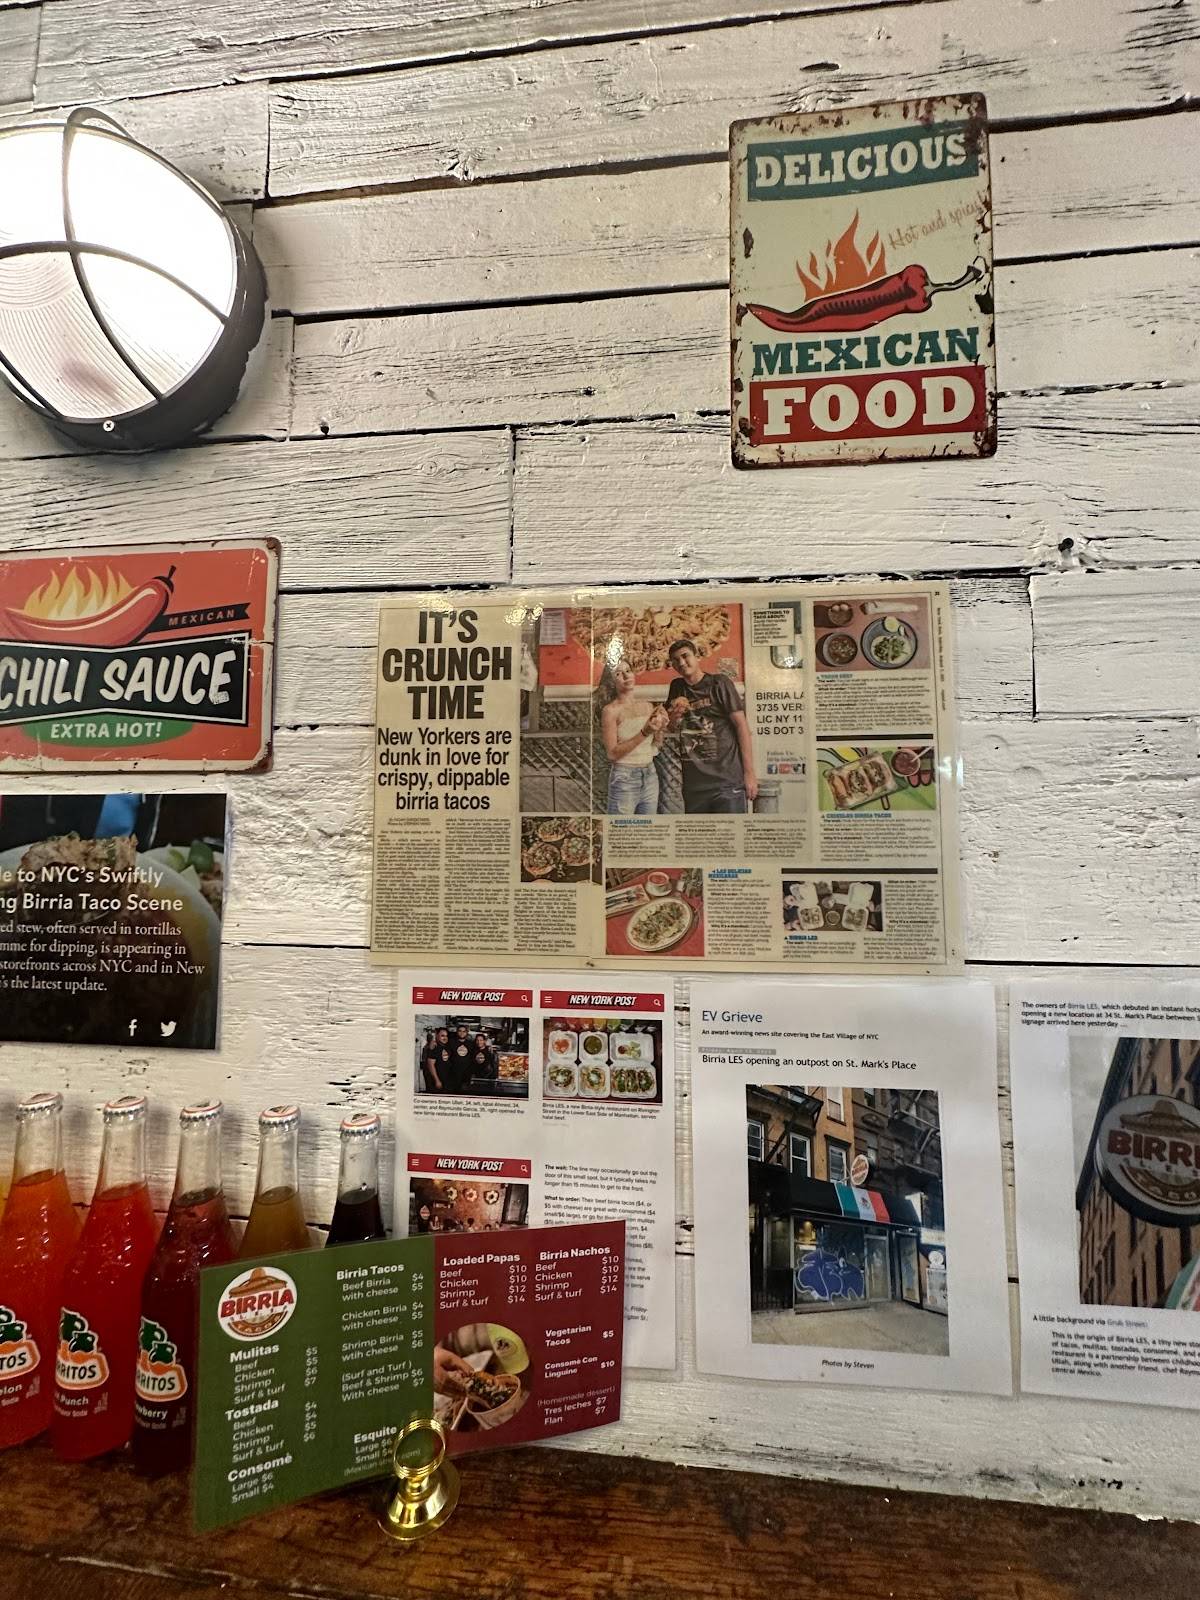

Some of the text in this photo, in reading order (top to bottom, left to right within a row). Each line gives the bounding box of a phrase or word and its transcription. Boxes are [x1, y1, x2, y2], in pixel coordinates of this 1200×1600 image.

[755, 133, 968, 188] DELICIOUS
[889, 225, 918, 250] Hot
[752, 326, 980, 377] MEXICAN
[762, 375, 976, 437] FOOD
[168, 608, 236, 628] MEXICAN
[418, 609, 479, 645] IT'S
[381, 646, 512, 682] CRUNCH
[0, 650, 237, 710] CHILI SAUCE
[407, 685, 485, 720] TIME
[756, 691, 790, 701] BIRRIA
[756, 702, 805, 712] 3735 VER
[756, 715, 773, 723] LIC
[775, 715, 790, 723] NY
[50, 721, 163, 739] EXTRA HOT!
[377, 727, 512, 746] New Yorkers are
[757, 726, 805, 735] US DOT 3
[379, 747, 510, 766] dunk in love for
[377, 768, 510, 791] crispy, dippable
[396, 791, 491, 810] birria tacos
[17, 868, 36, 882] to
[41, 867, 94, 883] NYC's
[98, 867, 164, 888] Swiftly
[23, 892, 73, 910] Birria
[78, 893, 122, 911] Taco
[127, 893, 184, 911] Scene
[16, 924, 45, 936] stew,
[47, 920, 77, 935] often
[80, 921, 117, 936] served
[120, 924, 132, 936] in
[134, 922, 182, 937] tortillas
[29, 938, 48, 952] for
[49, 939, 98, 957] dipping,
[100, 942, 111, 954] is
[113, 943, 172, 959] appearing
[174, 942, 187, 955] in
[0, 957, 206, 976] storefronts across NYC and in New
[11, 975, 30, 989] the
[32, 976, 62, 990] latest
[64, 977, 108, 995] update.
[440, 991, 506, 1003] NEW YORK POST
[570, 994, 637, 1007] NEW YORK POST
[701, 1010, 763, 1023] EV Grieve
[1102, 1003, 1121, 1011] which
[1122, 1004, 1150, 1012] debuted
[1161, 1005, 1184, 1013] instant
[711, 1029, 754, 1037] award-winning
[783, 1031, 809, 1039] covering
[836, 1033, 858, 1041] Village
[866, 1033, 880, 1041] NYC
[702, 1054, 726, 1064] Birria
[728, 1055, 744, 1064] LES
[745, 1055, 781, 1067] opening
[796, 1058, 830, 1068] outpost
[832, 1060, 844, 1068] on
[845, 1059, 859, 1068] St.
[861, 1060, 889, 1069] Mark's
[891, 1060, 917, 1070] Place
[436, 1157, 504, 1171] NEW YORK POST
[443, 1253, 520, 1267] Loaded Papas
[540, 1246, 611, 1261] Birria Nachos
[336, 1264, 405, 1281] Birria Tacos
[440, 1265, 527, 1279] Beef $10
[342, 1272, 424, 1293] Beef Birria $4
[440, 1274, 527, 1289] Chicken $10
[440, 1284, 526, 1299] Shrimp $12
[220, 1288, 295, 1319] BIRRIA
[440, 1295, 525, 1310] Surf & turf $14
[545, 1325, 614, 1339] Vegetarian $5
[545, 1338, 571, 1347] Tacos
[229, 1344, 280, 1364] Mulitas
[582, 1356, 598, 1364] Con
[600, 1360, 615, 1369] $10
[821, 1359, 843, 1367] Photos
[853, 1361, 875, 1369] Steven
[545, 1368, 578, 1379] Linguine
[61, 1394, 89, 1406] Punch
[545, 1396, 607, 1416] Tres leches $7
[224, 1399, 279, 1421] Tostada
[545, 1406, 607, 1426] Flan $7
[354, 1426, 398, 1444] Esquite
